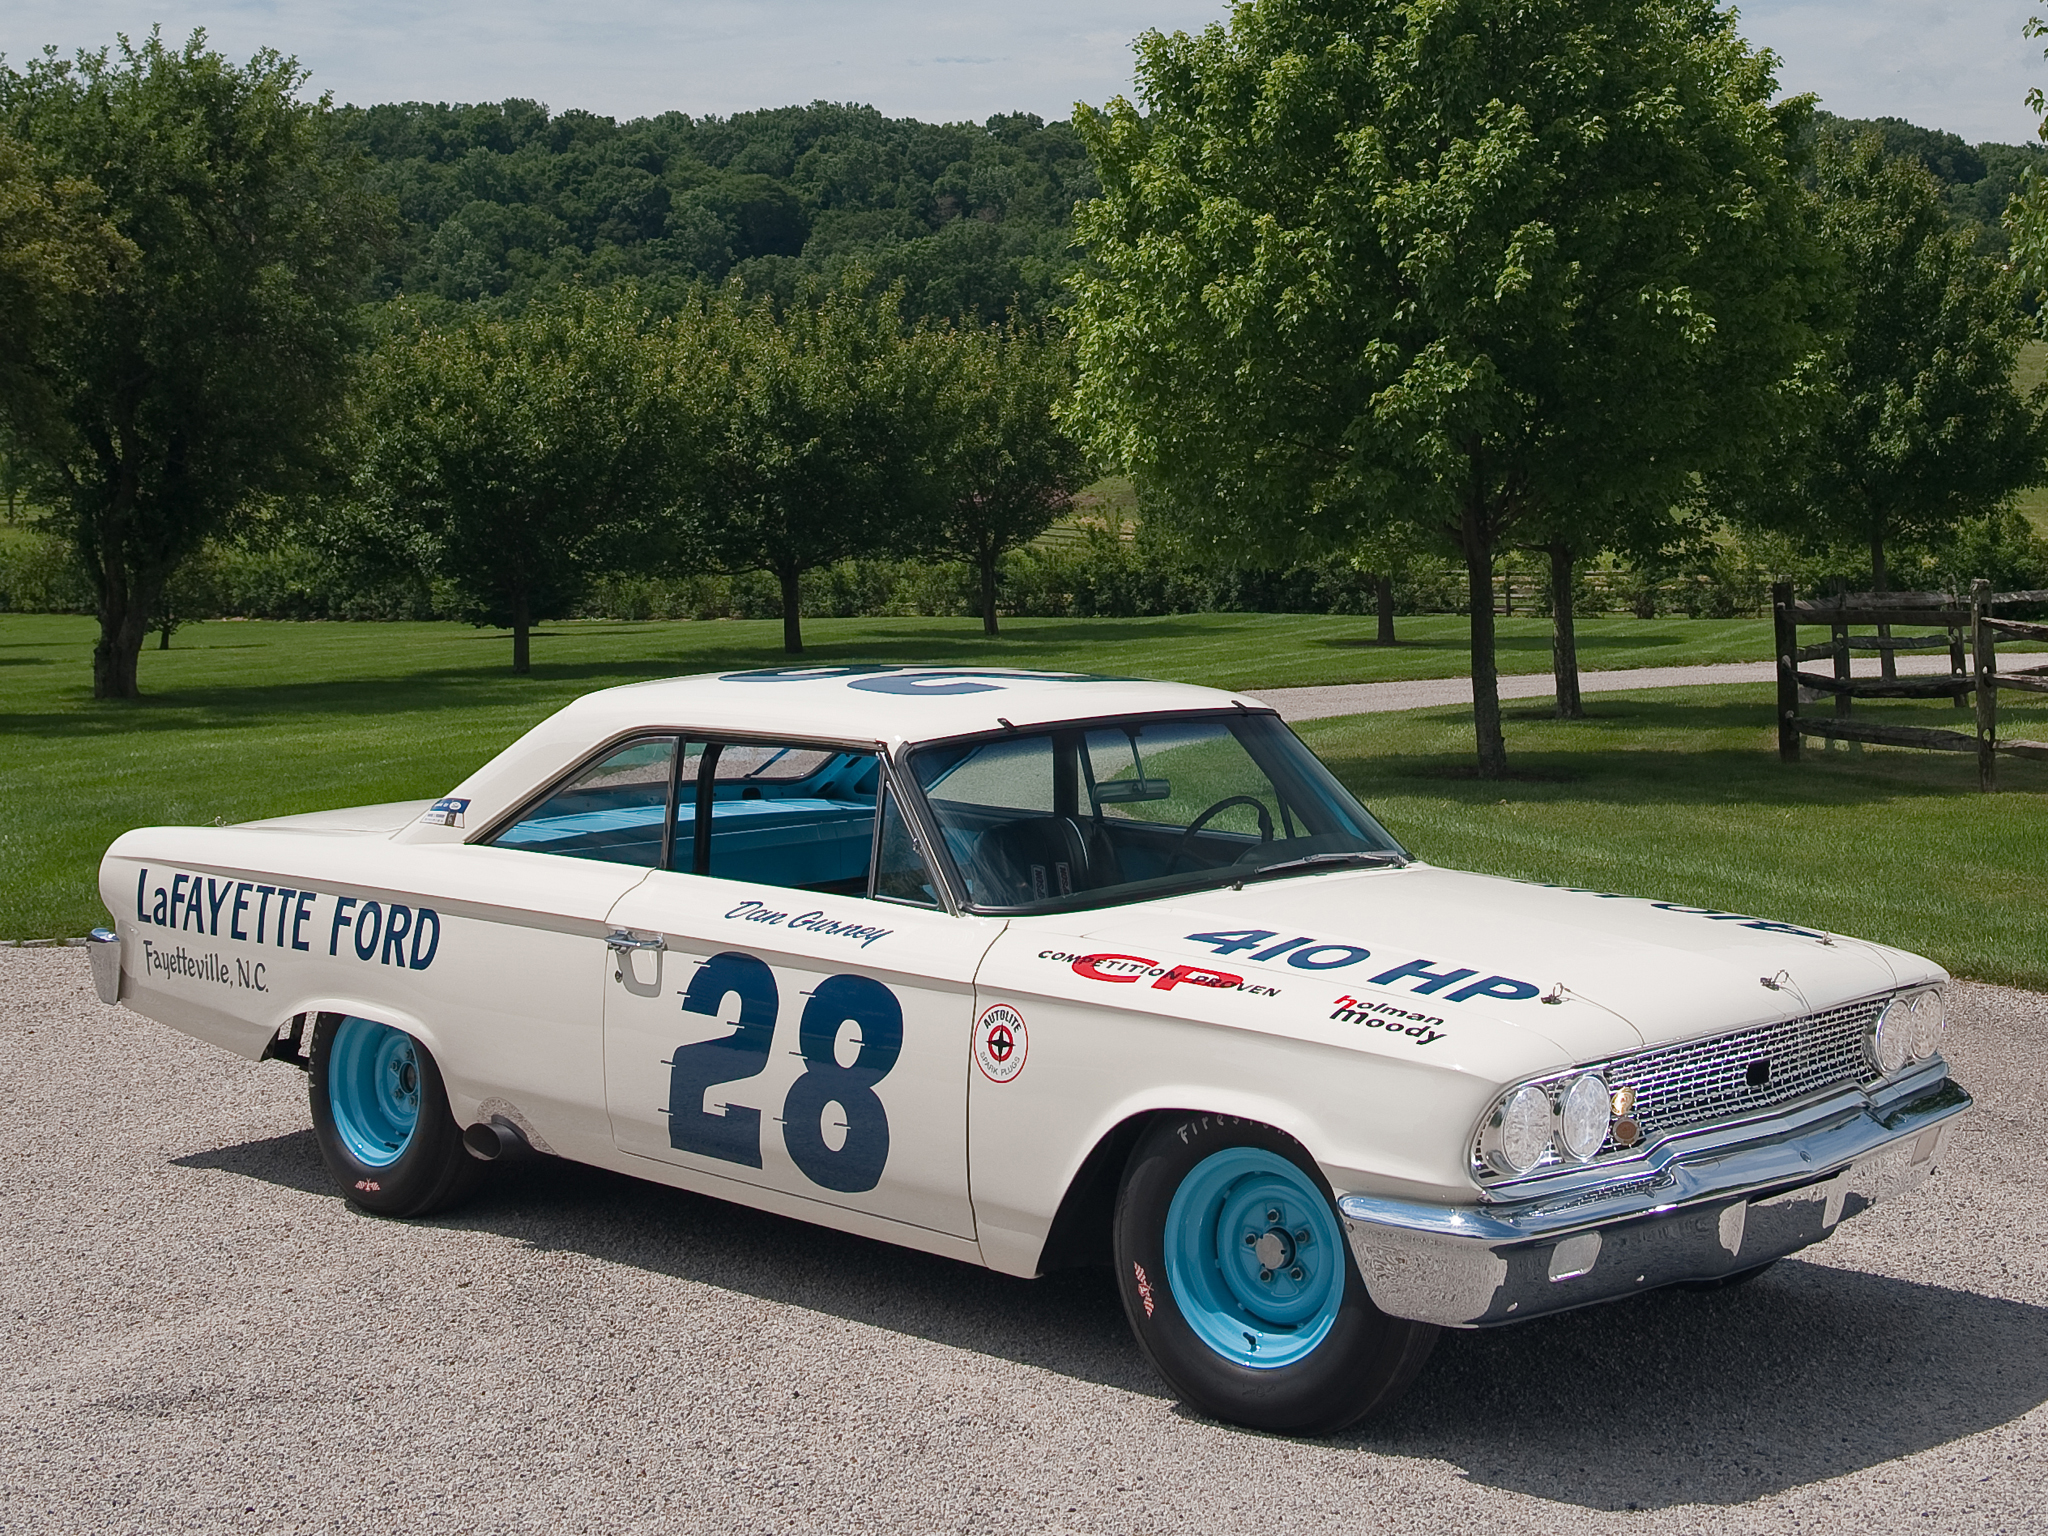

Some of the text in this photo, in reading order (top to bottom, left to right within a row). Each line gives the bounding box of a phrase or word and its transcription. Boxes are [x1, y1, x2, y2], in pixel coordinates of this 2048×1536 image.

[138, 868, 441, 971] LaFAYETTE FORD
[724, 901, 894, 949] Dan Gurney
[143, 940, 270, 993] Fayetteville, N.C.
[1038, 950, 1282, 997] COMPETITION PROVEN
[1072, 954, 1244, 991] CP
[1184, 929, 1541, 1003] 410 HP
[983, 1009, 1022, 1033] AUTOLITE
[1329, 1008, 1447, 1045] moody
[1333, 995, 1444, 1025] holman
[666, 951, 904, 1193] 28
[980, 1051, 1021, 1076] SPARK PLUGS
[1177, 1114, 1299, 1145] Fires
